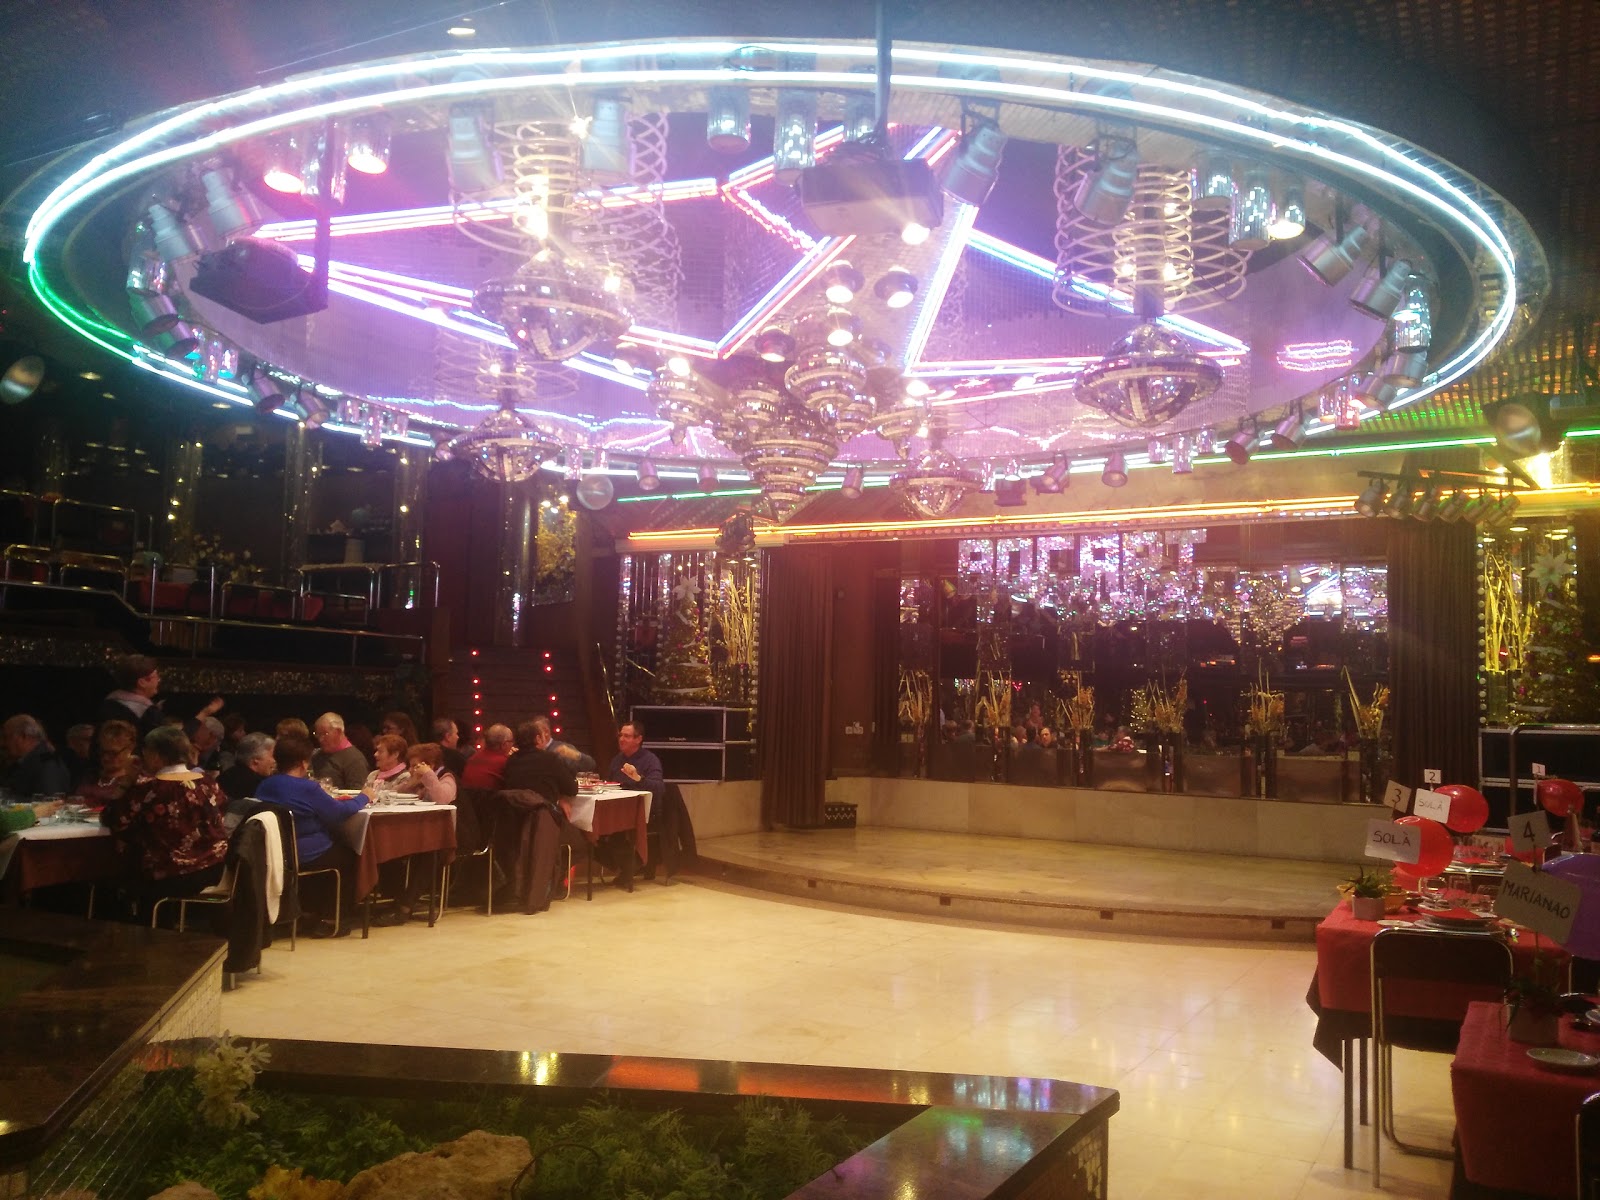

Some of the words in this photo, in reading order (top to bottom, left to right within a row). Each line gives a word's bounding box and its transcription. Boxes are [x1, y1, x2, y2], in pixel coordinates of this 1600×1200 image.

[1429, 771, 1436, 782] 2
[1391, 788, 1402, 804] 3
[1372, 830, 1411, 846] SOLÀ
[1523, 821, 1535, 842] 4
[1502, 880, 1570, 919] MARIANAO
